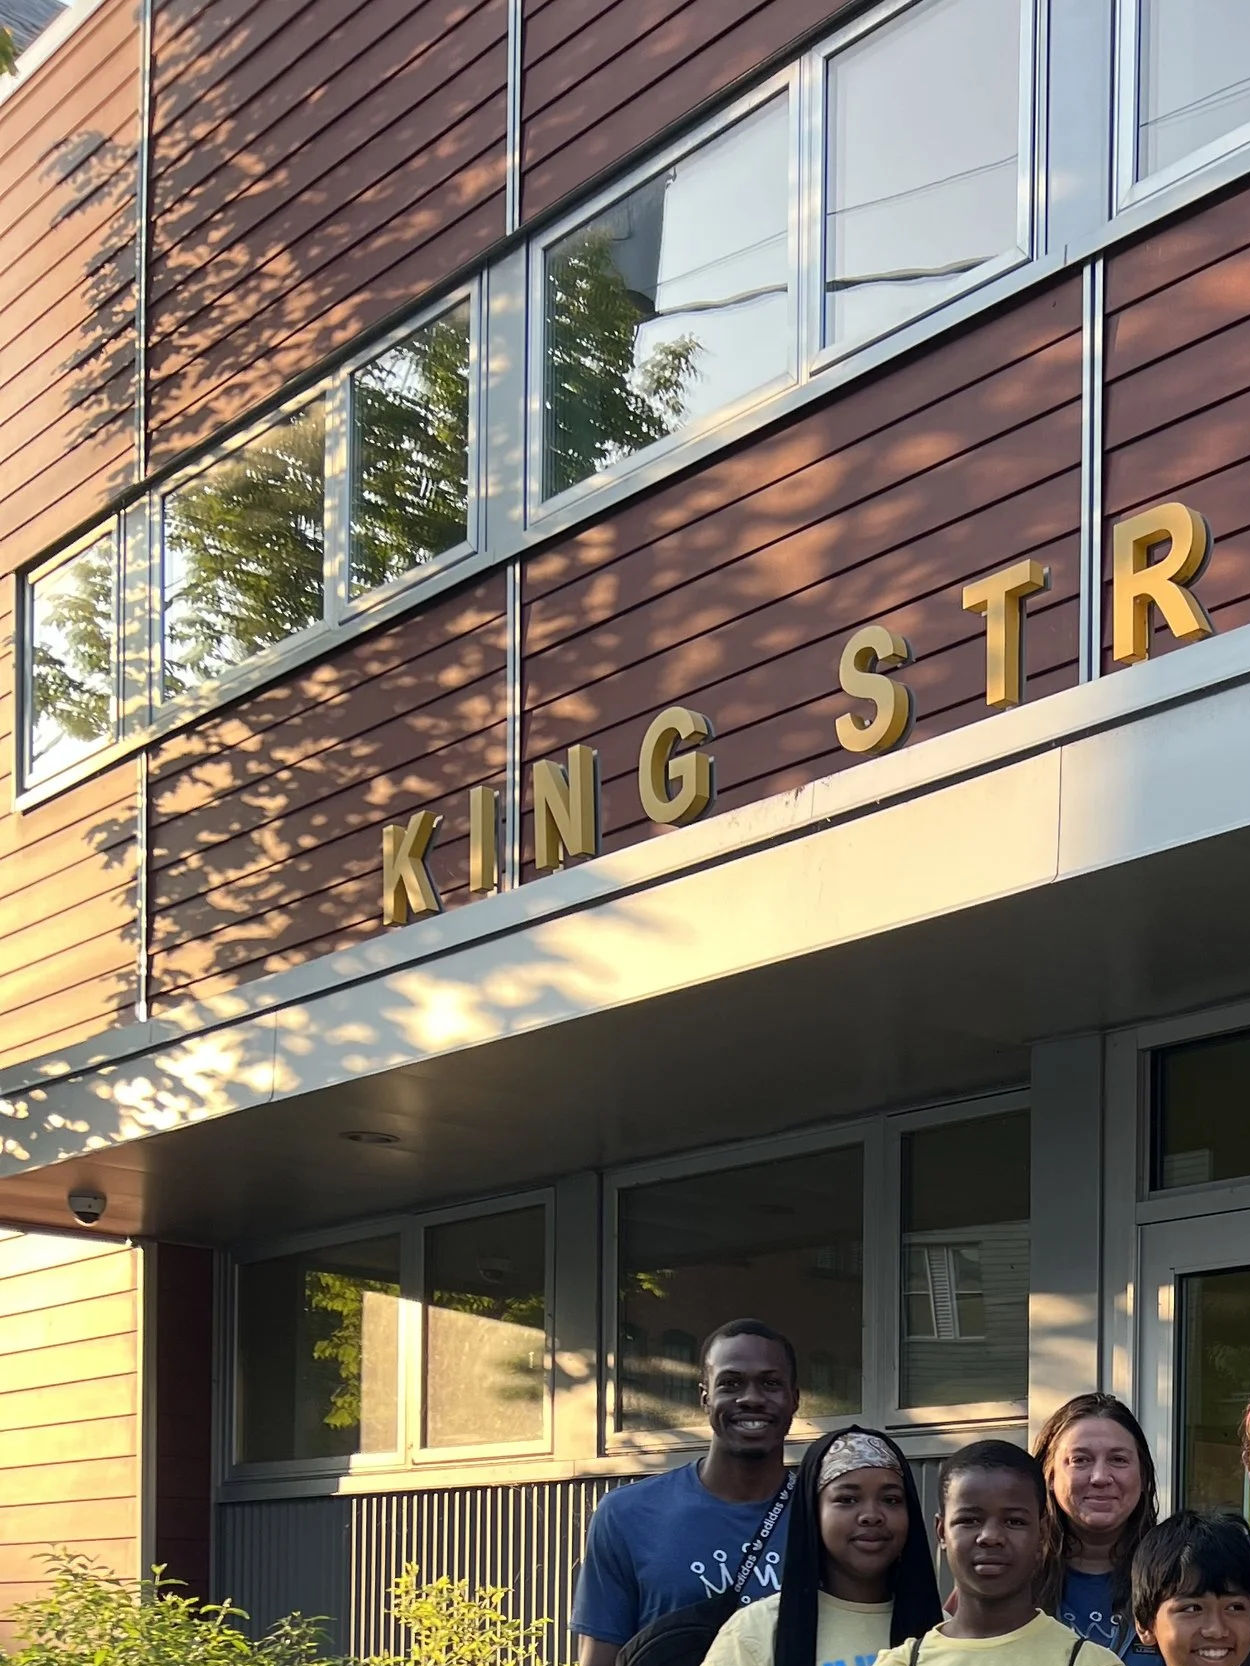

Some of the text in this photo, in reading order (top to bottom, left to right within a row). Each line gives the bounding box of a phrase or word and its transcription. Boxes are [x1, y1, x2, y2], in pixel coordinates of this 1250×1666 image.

[381, 705, 716, 926] KING
[734, 1554, 757, 1592] adidas
[760, 1502, 784, 1538] adidas
